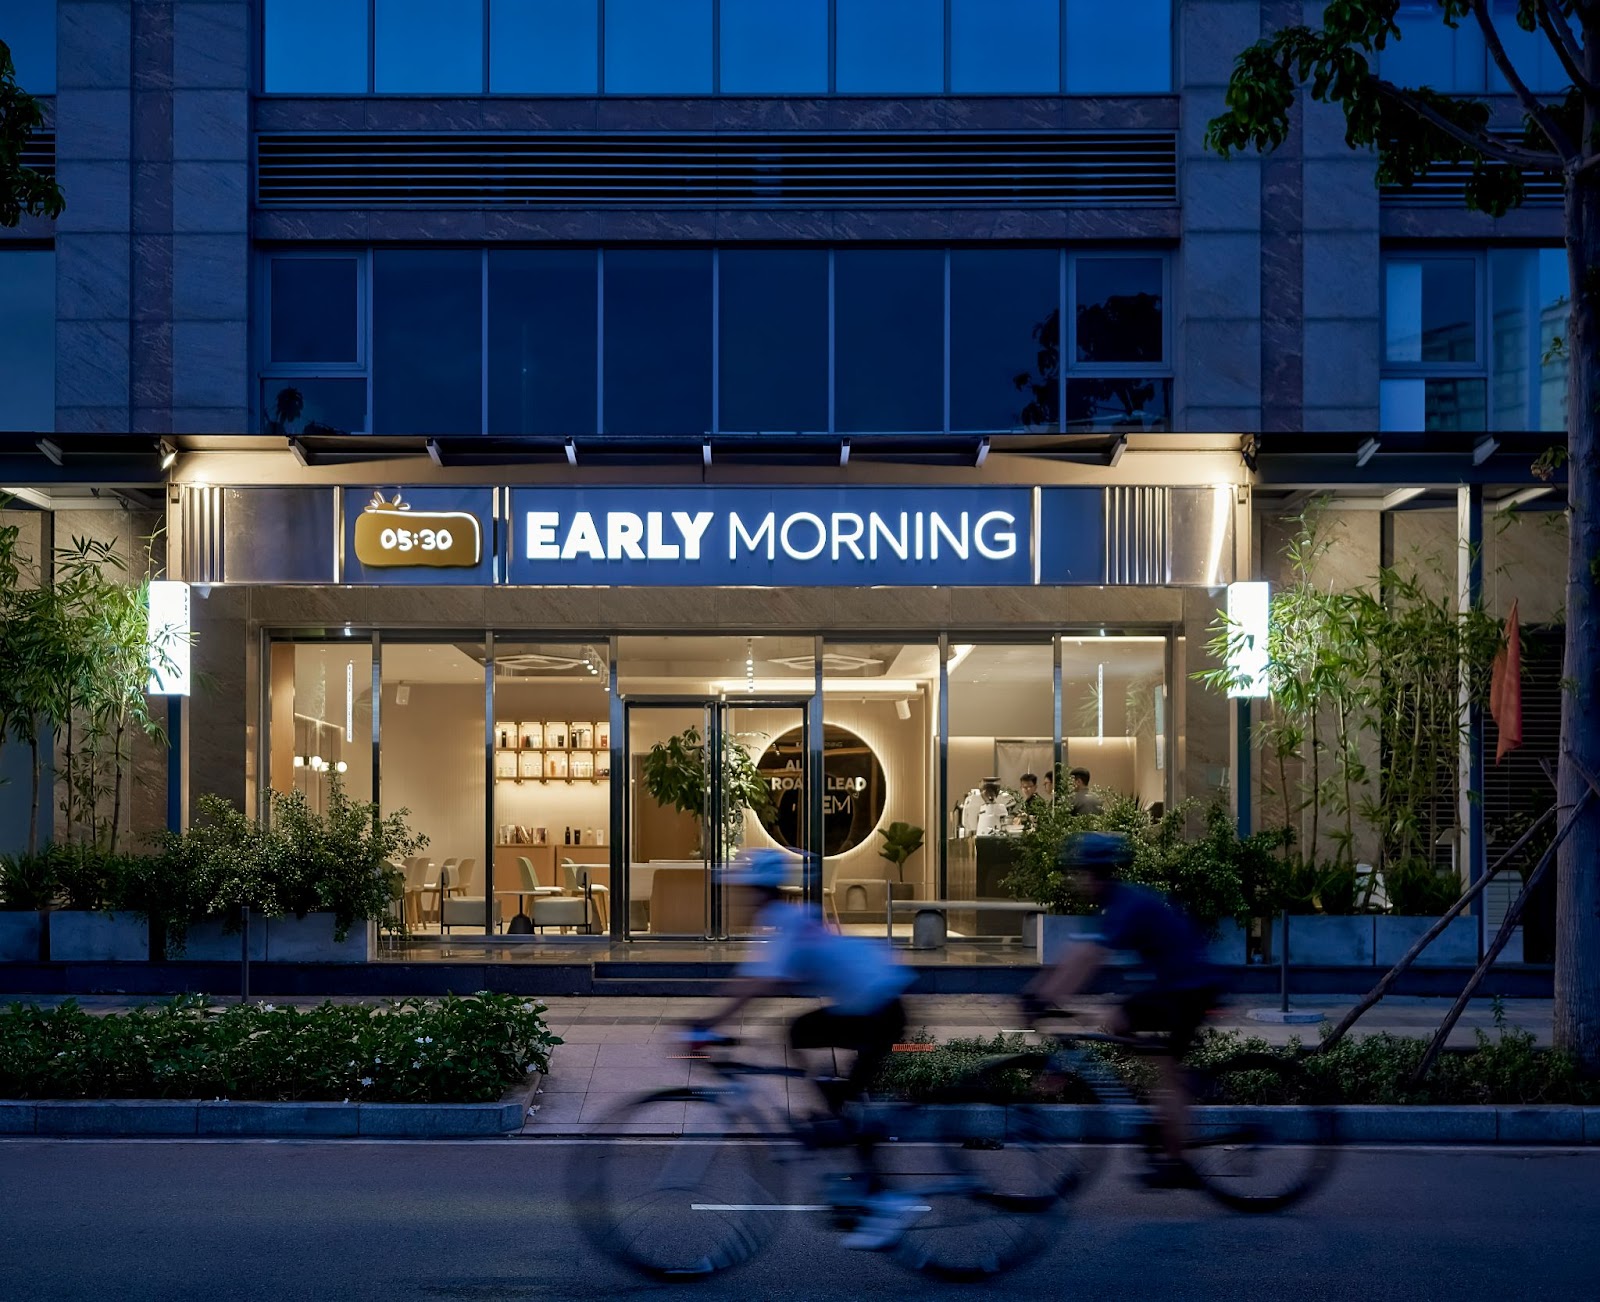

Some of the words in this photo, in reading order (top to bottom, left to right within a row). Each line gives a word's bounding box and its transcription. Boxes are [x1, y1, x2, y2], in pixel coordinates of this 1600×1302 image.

[381, 528, 453, 551] 05:30
[526, 511, 715, 560] EARLY
[729, 510, 1017, 560] MORNING
[771, 777, 803, 791] ROA
[827, 776, 867, 792] LEAD
